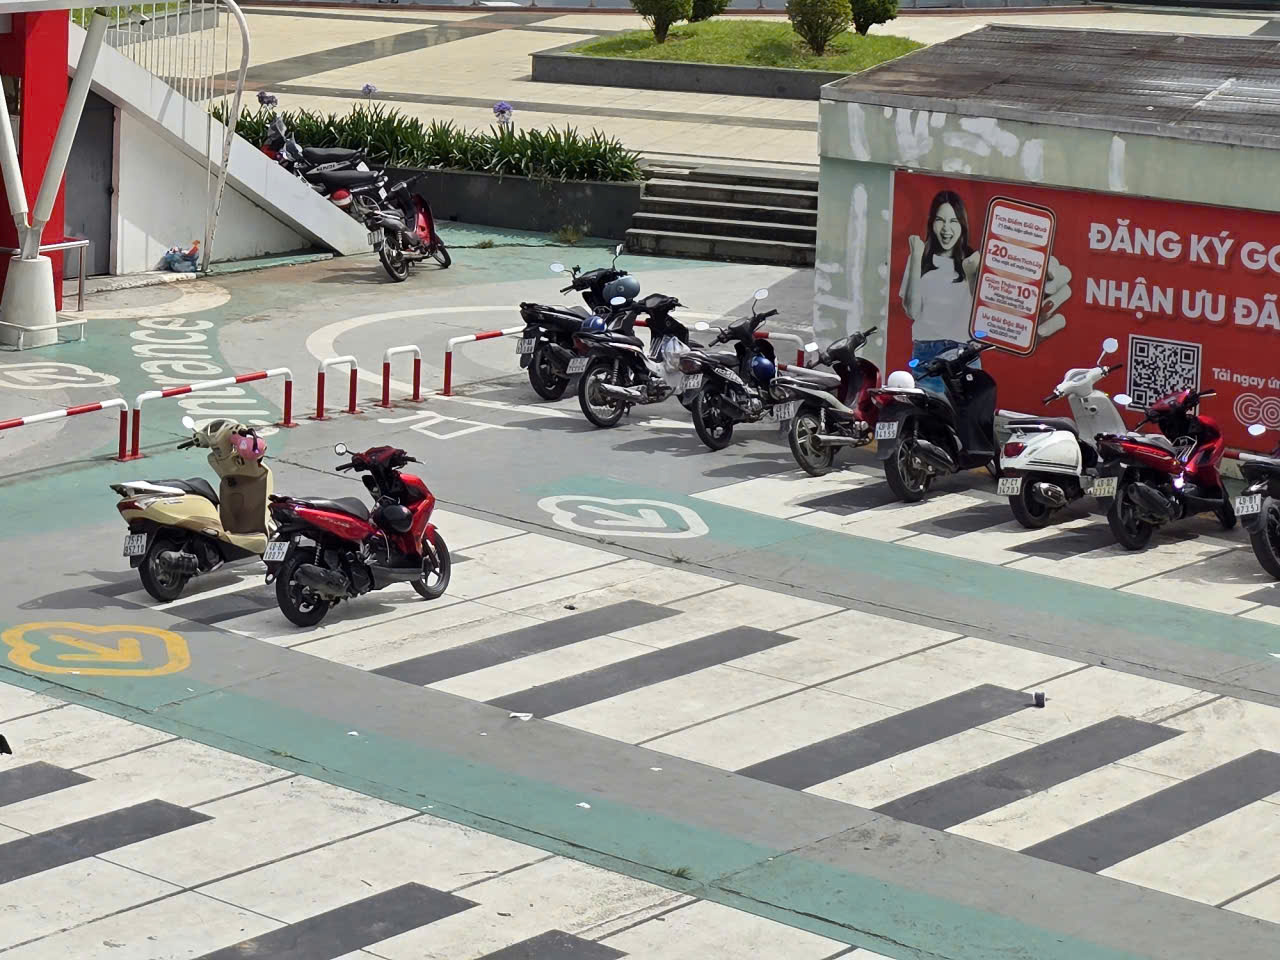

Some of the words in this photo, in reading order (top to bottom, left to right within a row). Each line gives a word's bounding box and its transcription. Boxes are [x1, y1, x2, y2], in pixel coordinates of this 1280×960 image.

[1088, 218, 1183, 259] ĐĂNG
[1189, 231, 1234, 266] KÝ
[1085, 276, 1174, 319] NHẬN
[1181, 289, 1226, 322] ƯU
[1212, 367, 1230, 381] Tải
[1233, 372, 1265, 389] ngay
